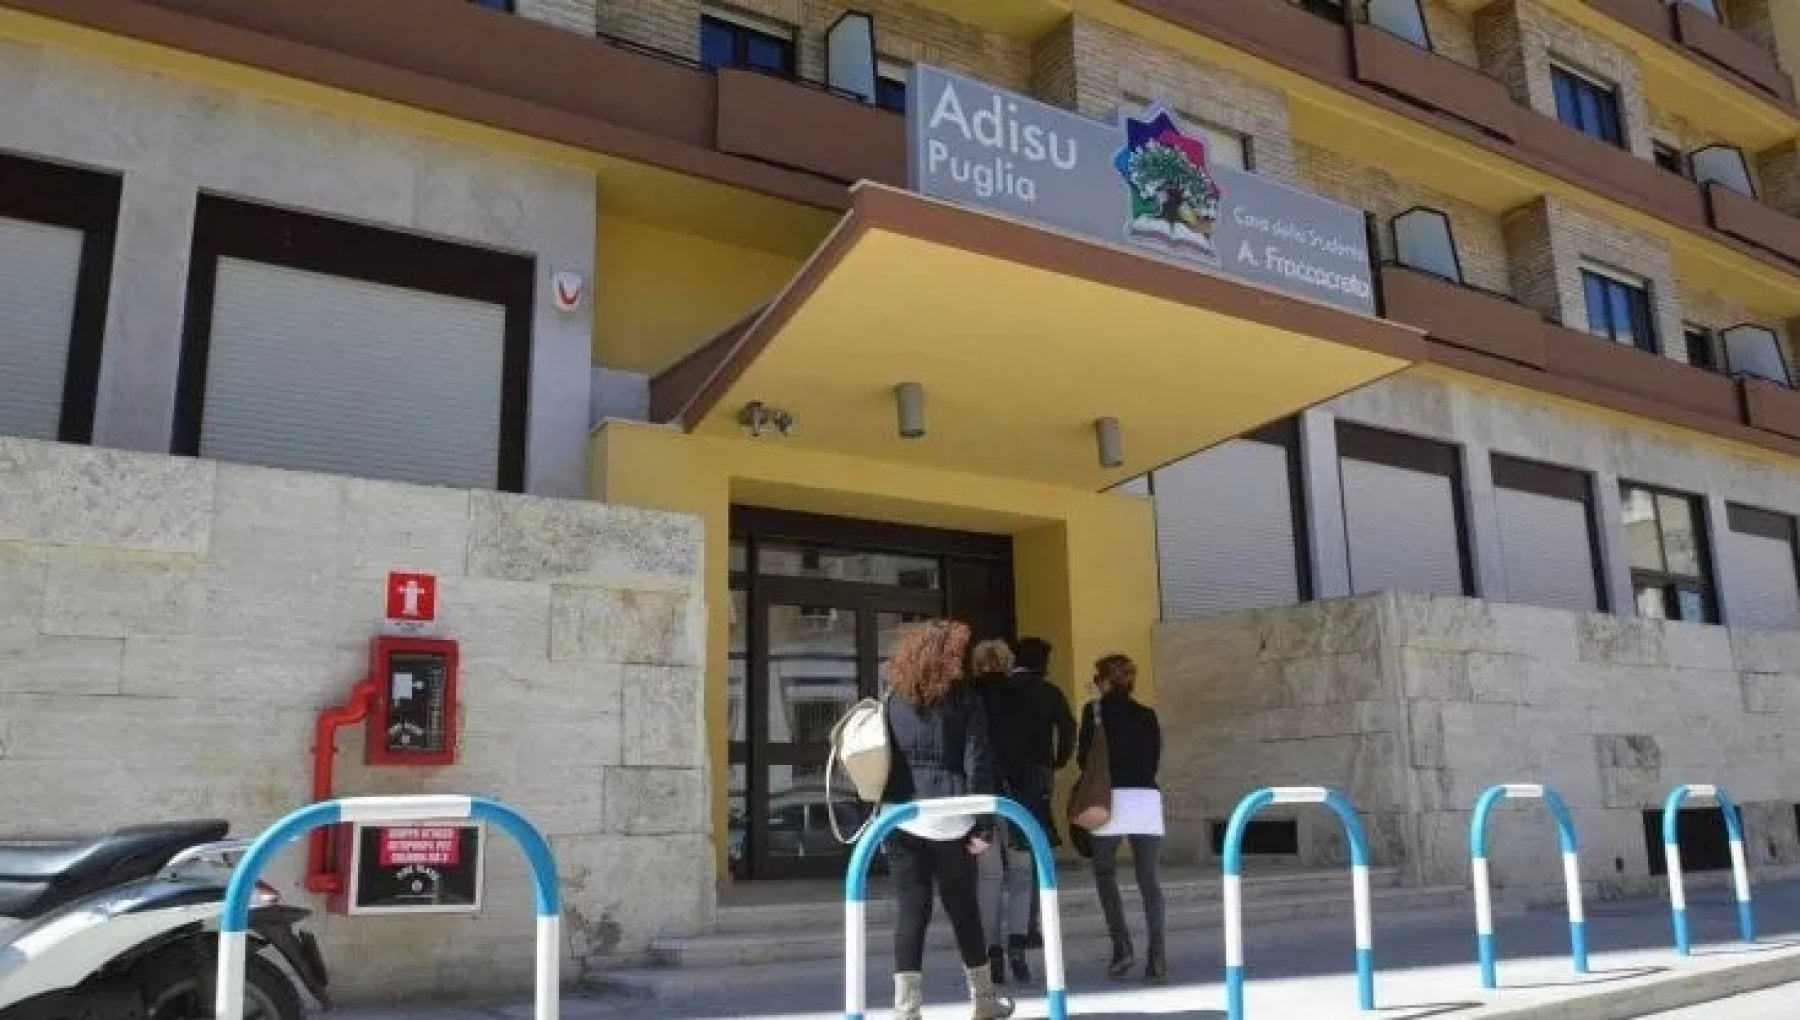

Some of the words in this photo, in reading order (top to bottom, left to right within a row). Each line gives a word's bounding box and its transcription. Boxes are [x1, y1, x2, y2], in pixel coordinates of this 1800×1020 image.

[928, 82, 1078, 170] Adisu
[928, 138, 1036, 201] Puglia
[1237, 239, 1259, 266] A.
